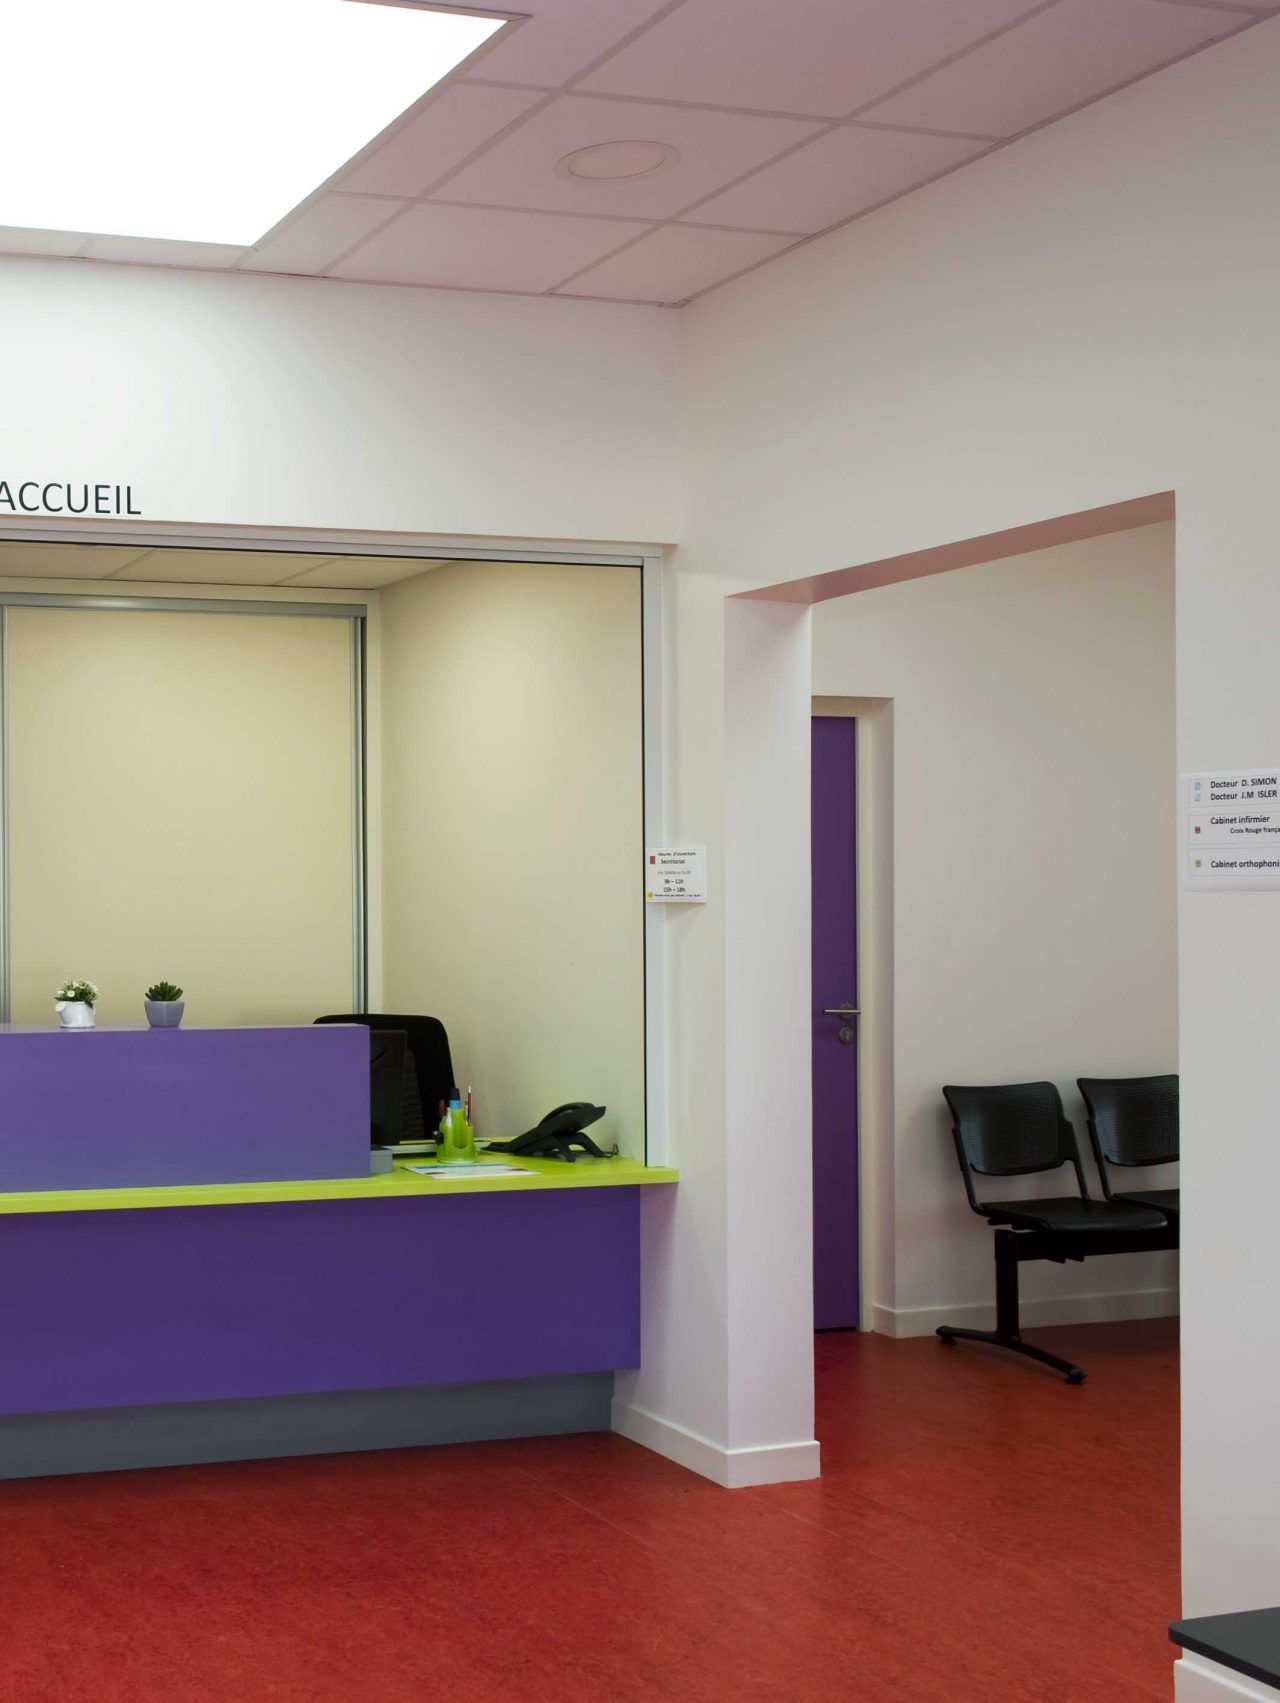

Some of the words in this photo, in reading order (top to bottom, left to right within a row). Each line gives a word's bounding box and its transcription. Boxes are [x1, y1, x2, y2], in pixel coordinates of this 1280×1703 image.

[1241, 779, 1250, 787] D.
[1251, 777, 1277, 786] SIMON
[1210, 793, 1238, 801] Docteur
[1257, 789, 1278, 798] ISLER
[1210, 816, 1237, 825] Cabinet
[1238, 814, 1270, 824] infirmier
[1245, 827, 1262, 835] Rouge
[1210, 860, 1238, 868] Cabinet
